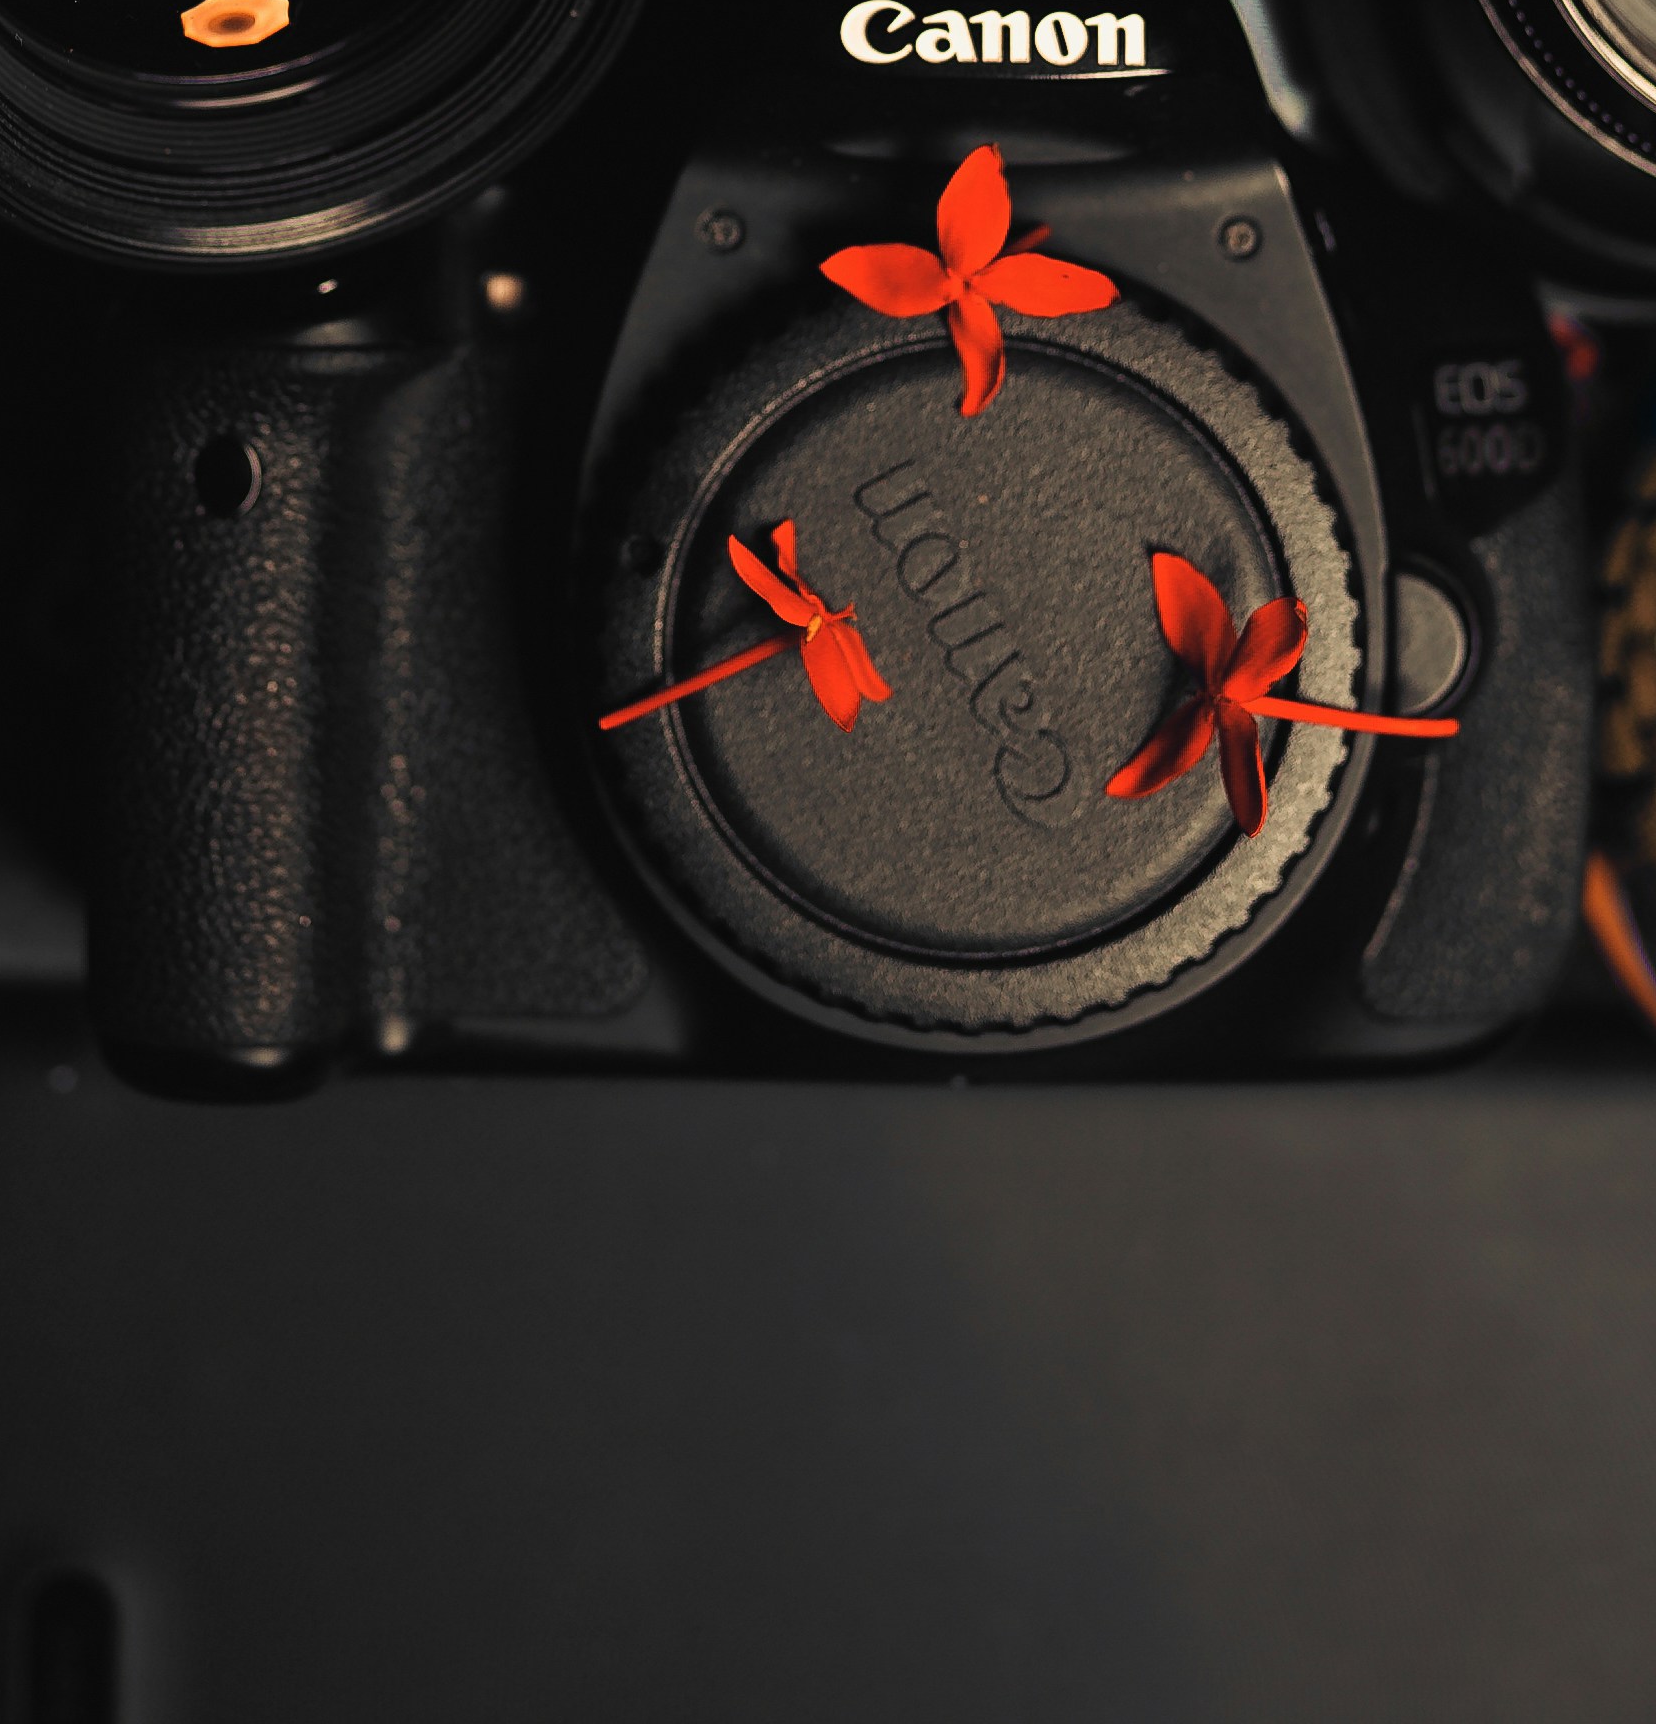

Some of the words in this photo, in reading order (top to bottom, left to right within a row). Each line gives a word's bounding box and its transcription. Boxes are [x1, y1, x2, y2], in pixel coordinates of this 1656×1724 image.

[840, 0, 1146, 67] Canon
[1433, 359, 1528, 416] EOS
[853, 458, 1083, 831] Canon
